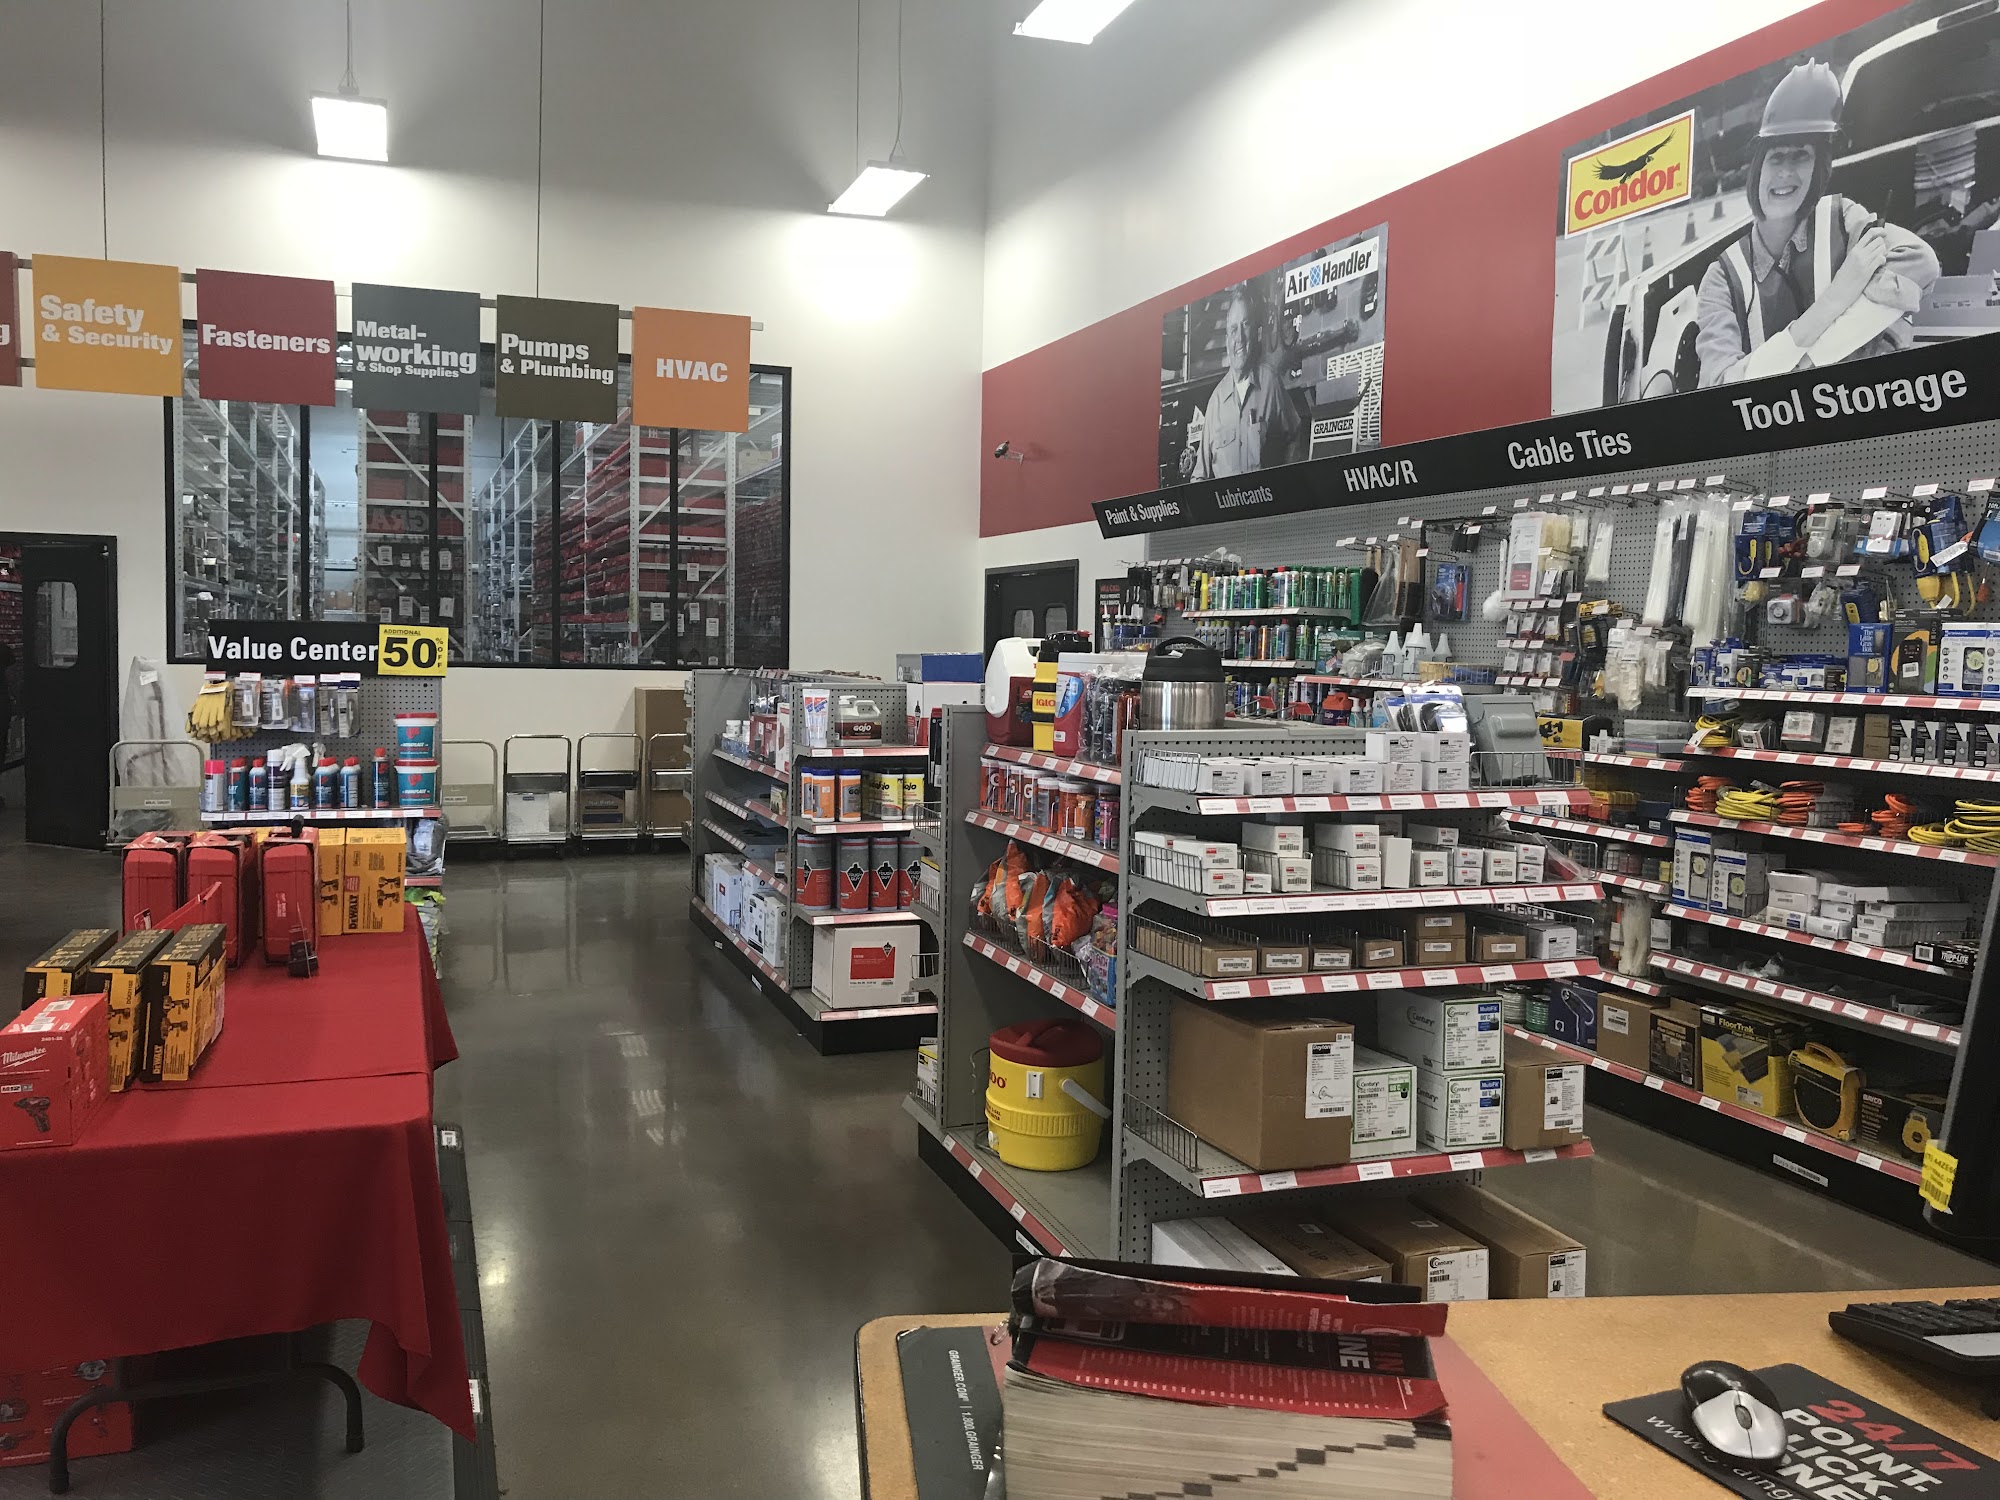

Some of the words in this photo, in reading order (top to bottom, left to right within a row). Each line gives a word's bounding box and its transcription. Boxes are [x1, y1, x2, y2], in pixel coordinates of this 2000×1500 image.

[1574, 162, 1681, 221] Condor
[1286, 272, 1310, 298] Air
[1321, 250, 1372, 285] Handler
[40, 294, 144, 333] Safety
[41, 323, 60, 343] &
[67, 325, 174, 356] Security
[202, 323, 331, 354] Fasteners
[356, 320, 427, 342] Metal-
[355, 343, 477, 374] working
[500, 332, 590, 362] Pumps
[355, 361, 367, 373] &
[369, 362, 402, 378] Shop
[404, 364, 460, 379] Supplies
[500, 357, 515, 375] &
[521, 360, 614, 385] Plumbing
[655, 357, 729, 383] HVAC
[1732, 388, 1806, 432] Tool
[1811, 368, 1968, 420] Storage
[1313, 418, 1354, 435] GRAINGER
[1507, 428, 1575, 471] Cable
[1576, 429, 1633, 461] Ties
[1343, 459, 1418, 492] HVAC/R
[1214, 485, 1274, 510] Lubricants
[1105, 507, 1129, 527] Paint
[1129, 508, 1138, 522] &
[1138, 500, 1181, 523] Supplies
[208, 635, 283, 661] Value
[290, 636, 378, 662] Center
[382, 637, 438, 669] 50
[1036, 698, 1056, 707] IGLO
[1407, 1006, 1435, 1026] Century
[1718, 1017, 1755, 1034] FloorTrak
[0, 1047, 47, 1065] Milwaukee
[1430, 1256, 1455, 1269] Century
[1806, 1399, 1980, 1471] 24/7
[1781, 1408, 1943, 1492] POINT.
